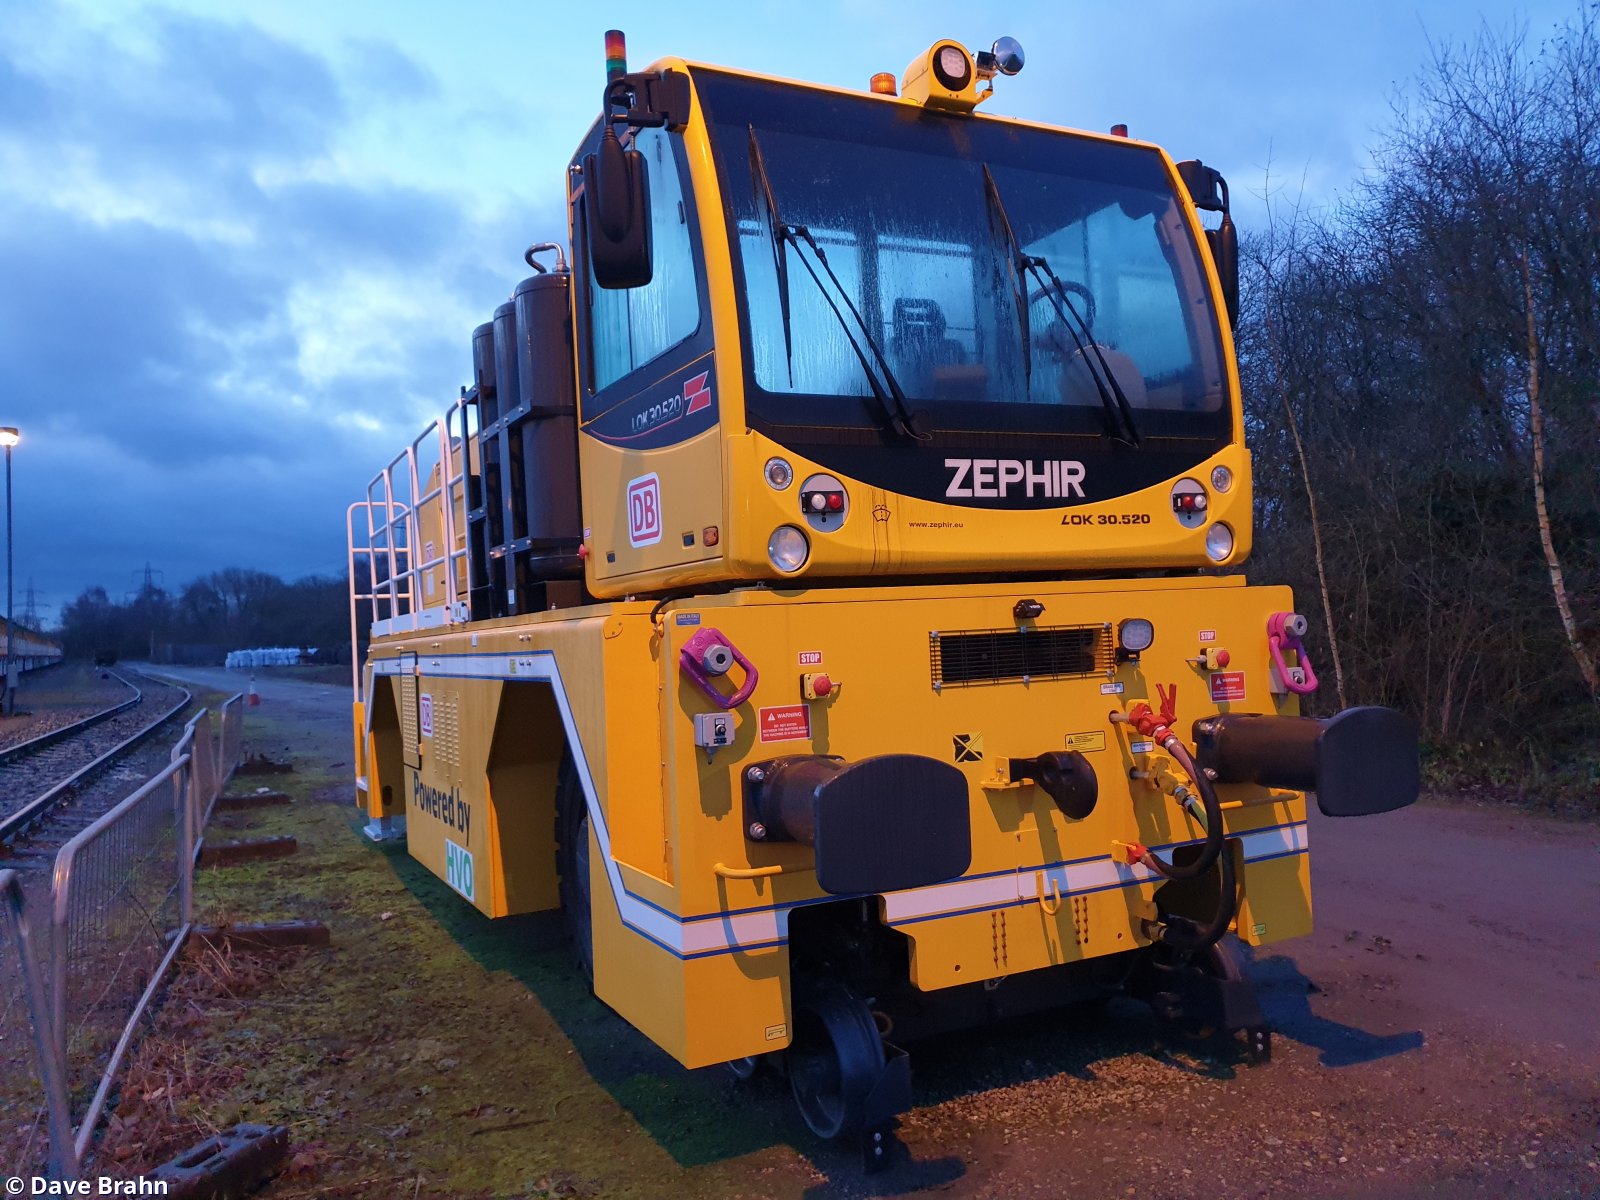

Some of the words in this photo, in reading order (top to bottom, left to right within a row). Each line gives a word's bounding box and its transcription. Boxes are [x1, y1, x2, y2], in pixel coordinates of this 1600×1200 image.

[945, 458, 1086, 498] ZEPHIR
[632, 489, 656, 533] DB
[908, 520, 964, 530] www.zephir.eu
[1060, 514, 1094, 526] LOK
[1097, 513, 1151, 526] 30.520
[1200, 632, 1215, 640] STOP
[801, 653, 820, 663] STOP
[776, 711, 802, 719] WARNING
[413, 770, 455, 828] Powered
[457, 787, 471, 847] by
[446, 840, 473, 898] HVO
